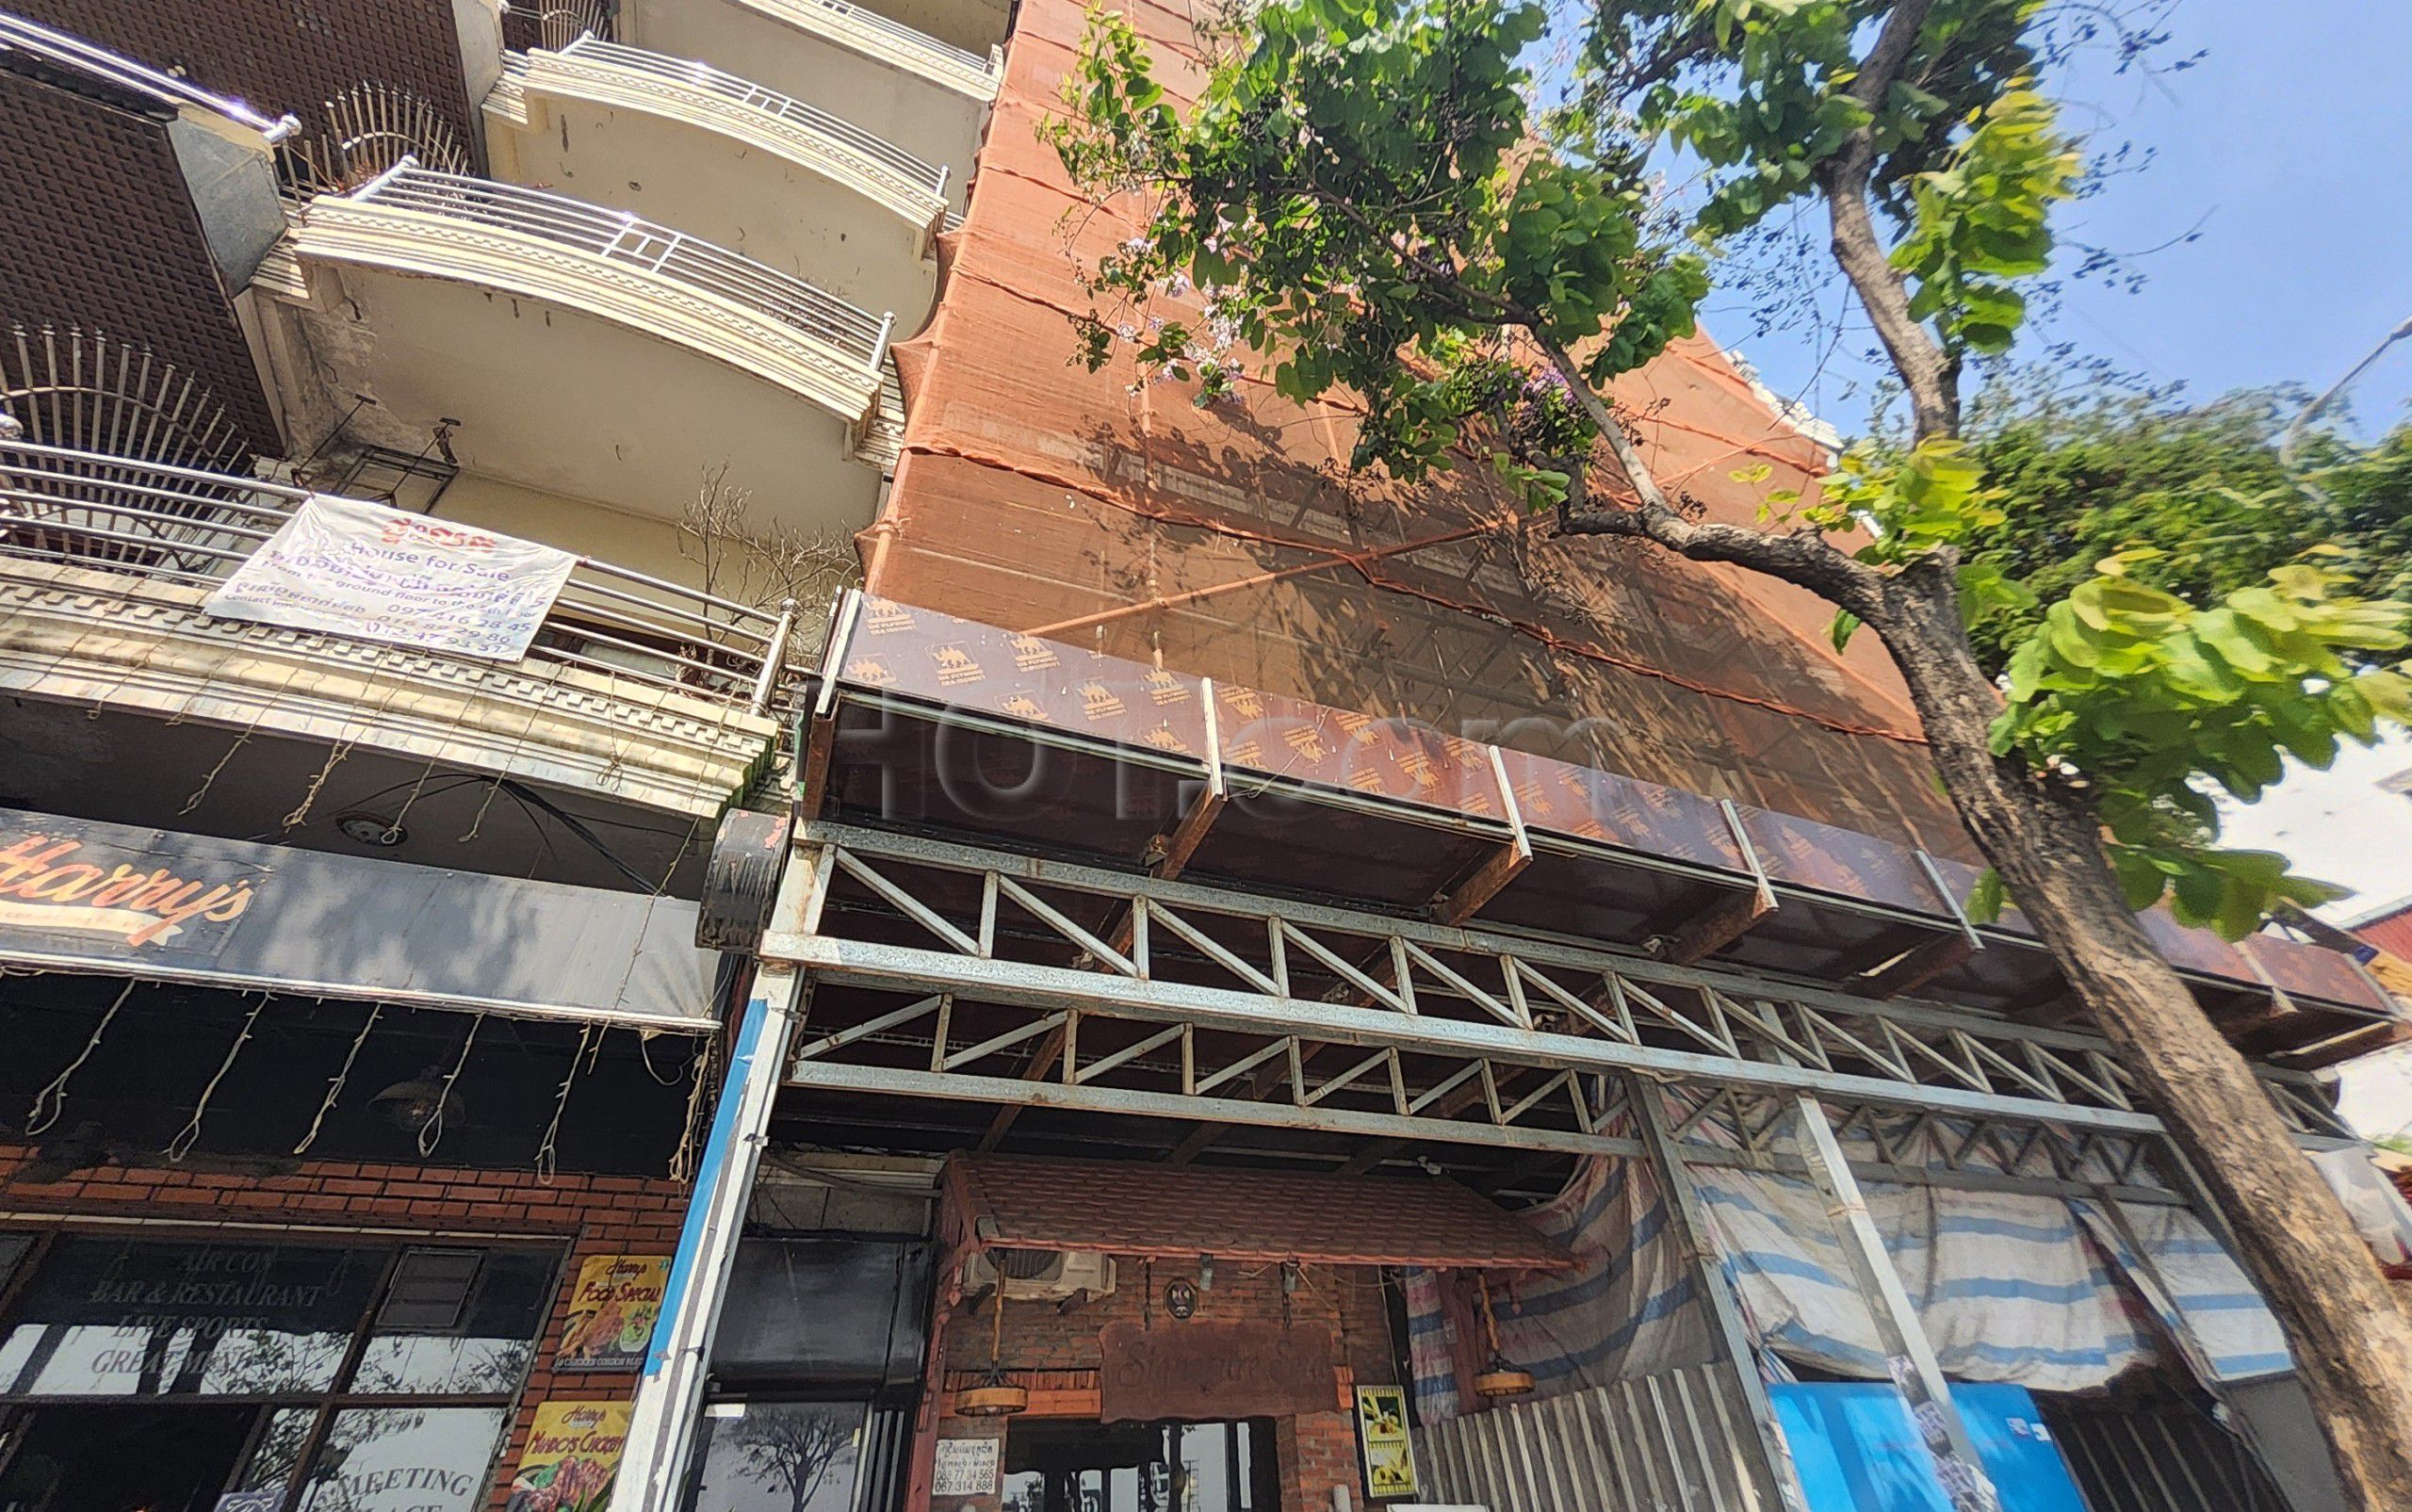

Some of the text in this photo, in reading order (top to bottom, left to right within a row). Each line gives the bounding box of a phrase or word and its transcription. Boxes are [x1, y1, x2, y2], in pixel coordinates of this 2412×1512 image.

[351, 542, 510, 582] House for Sale
[336, 580, 391, 602] ground
[395, 588, 429, 604] floor
[432, 593, 448, 606] to
[386, 604, 427, 618] 097
[477, 617, 502, 629] 28
[507, 620, 531, 634] 45
[447, 635, 470, 650] 93
[455, 625, 481, 639] 29
[485, 631, 511, 645] 86
[90, 1279, 325, 1308] BAR & RESTAURANT
[339, 1467, 474, 1497] MEETING
